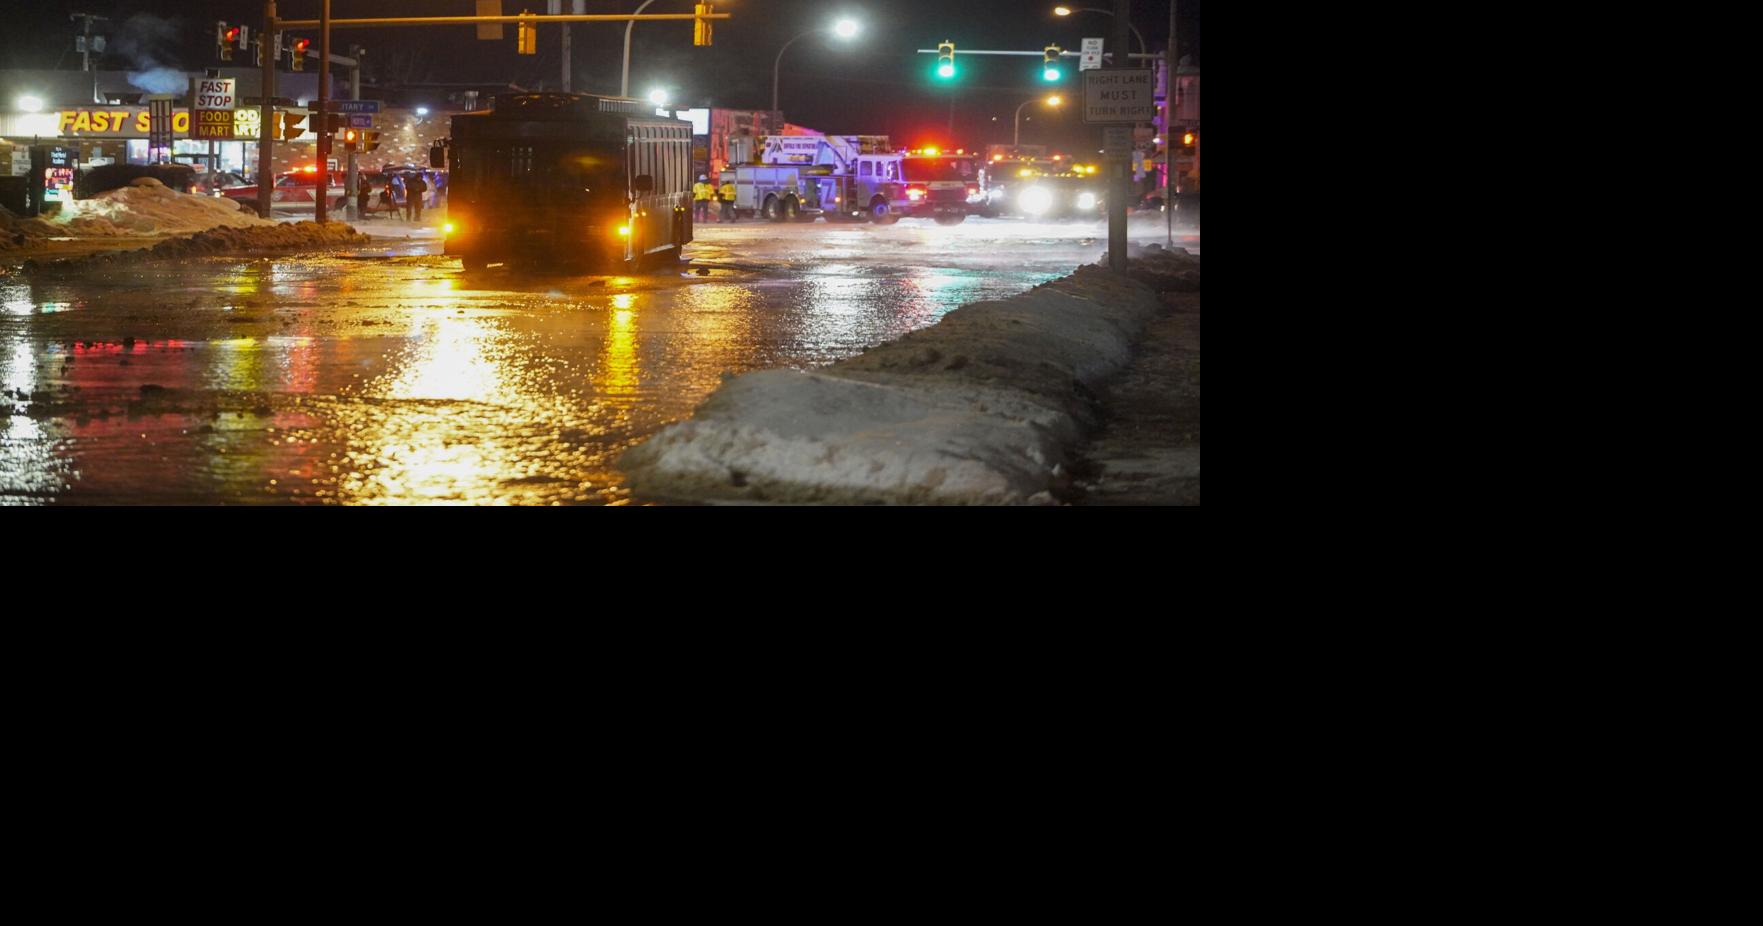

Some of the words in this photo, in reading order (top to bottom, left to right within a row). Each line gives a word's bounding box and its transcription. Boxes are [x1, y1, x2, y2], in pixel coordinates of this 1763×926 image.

[1088, 75, 1118, 85] RIGHT
[1122, 75, 1149, 85] LANE
[200, 81, 231, 93] FAST
[1100, 90, 1137, 101] MUST
[198, 96, 232, 107] STOP
[200, 111, 231, 122] FOOD
[234, 109, 259, 121] OD
[1089, 106, 1116, 116] TURN
[1120, 106, 1150, 116] RIGHT
[59, 110, 130, 133] FAST
[135, 110, 189, 133] SO
[199, 126, 230, 137] MART
